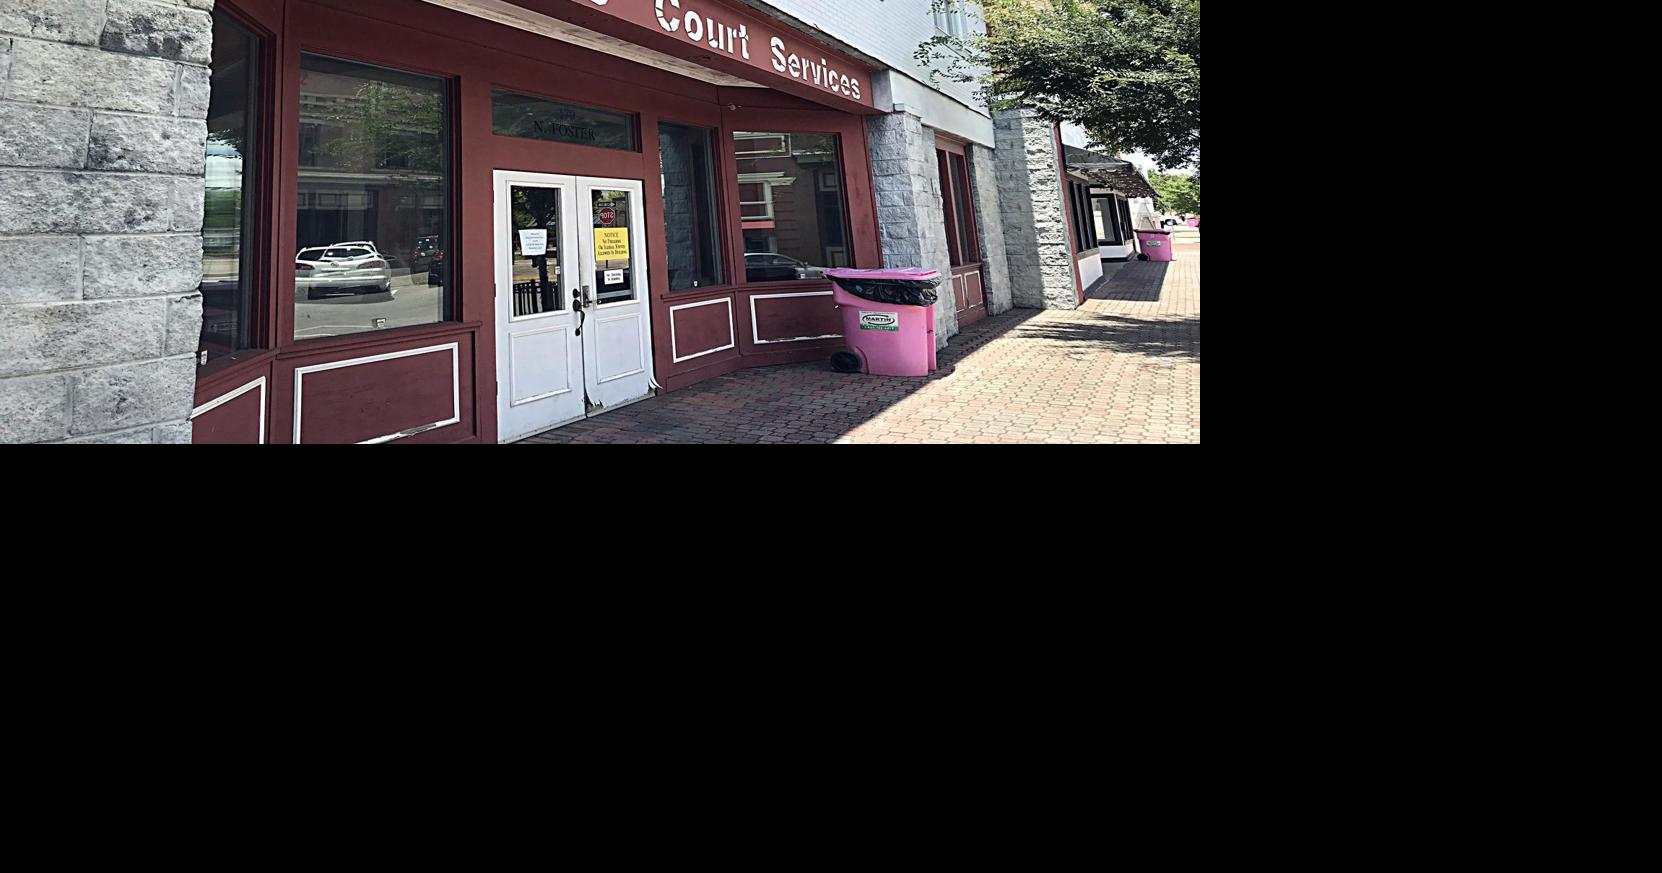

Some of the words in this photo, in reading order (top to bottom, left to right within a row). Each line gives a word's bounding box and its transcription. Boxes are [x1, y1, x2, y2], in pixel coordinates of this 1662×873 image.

[654, 0, 750, 60] Court
[770, 36, 861, 100] Services
[552, 122, 596, 141] FOSTER
